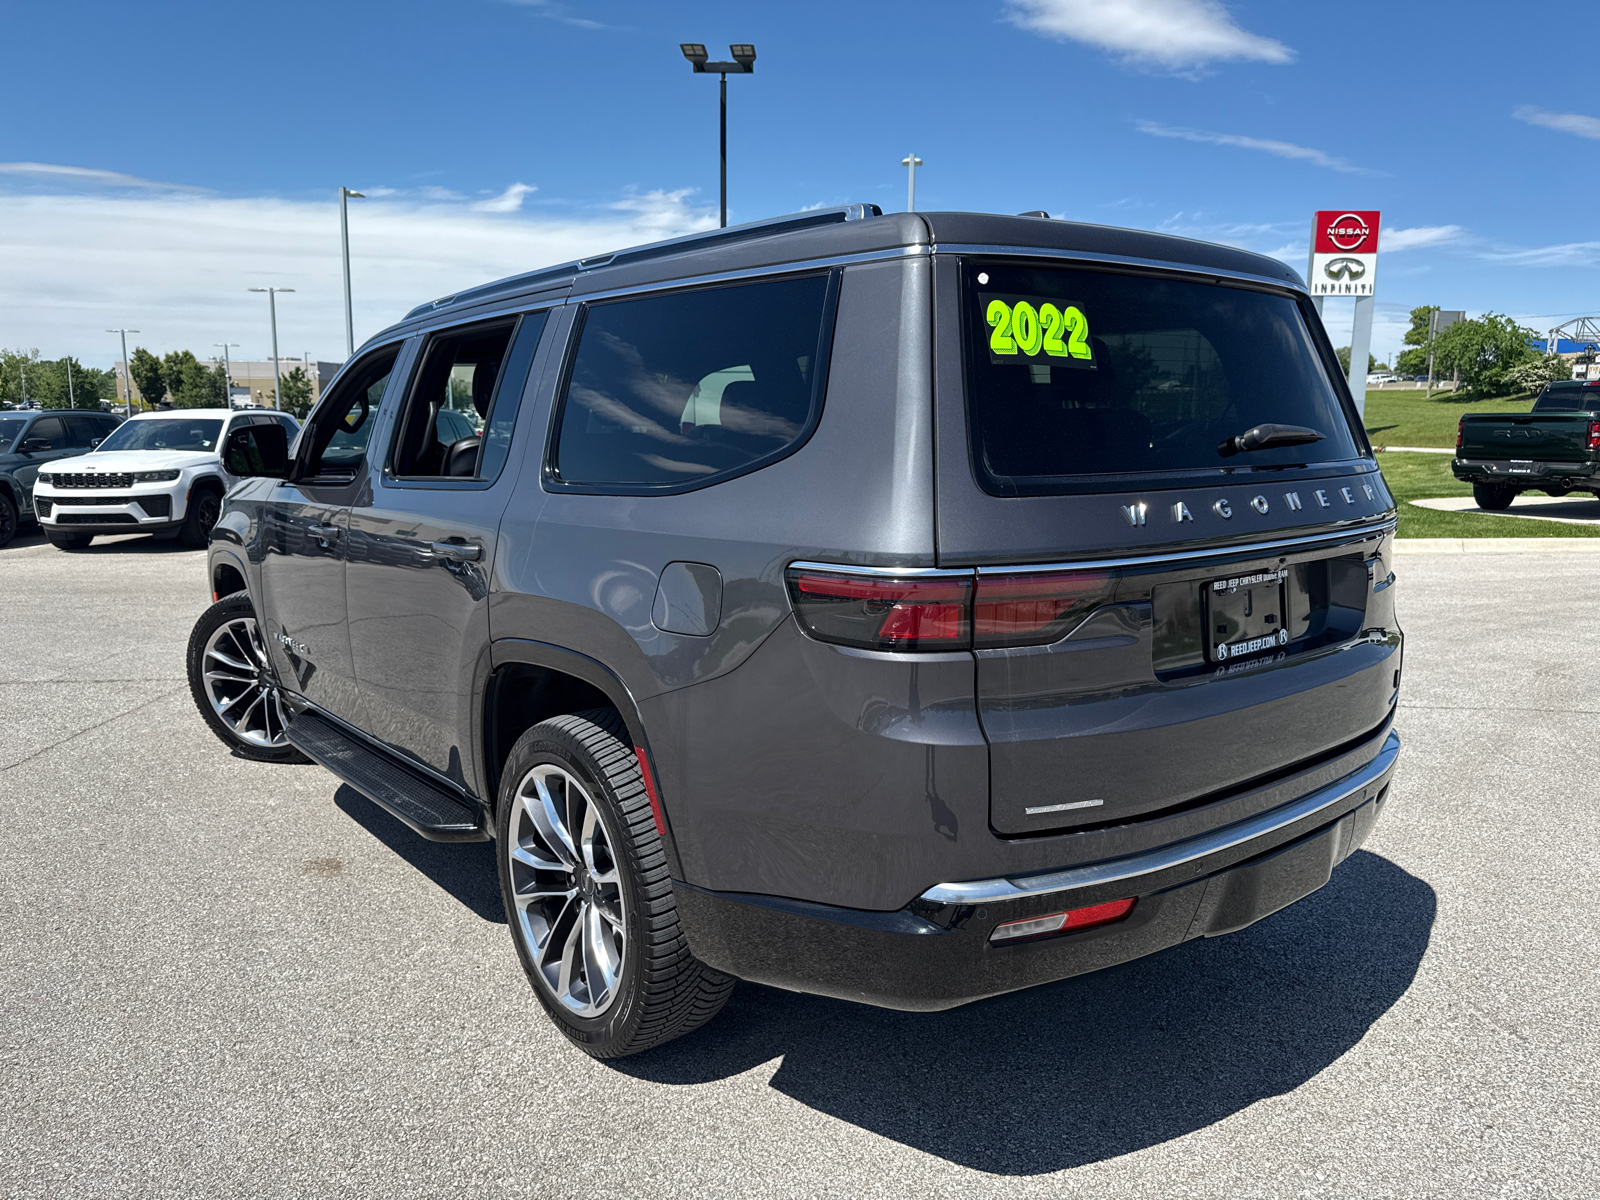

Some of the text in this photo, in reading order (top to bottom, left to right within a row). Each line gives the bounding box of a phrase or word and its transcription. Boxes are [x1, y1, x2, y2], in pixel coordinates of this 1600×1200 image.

[1314, 284, 1372, 294] INFINITI
[987, 300, 1092, 360] 2022
[1493, 430, 1550, 438] RAM
[1120, 484, 1376, 526] WAGONEER
[1213, 580, 1227, 591] REED
[1228, 578, 1239, 588] JEEP
[1240, 574, 1263, 586] CHRYSLER
[1277, 569, 1288, 579] RAM
[1230, 636, 1276, 657] REEDJEEP.COM
